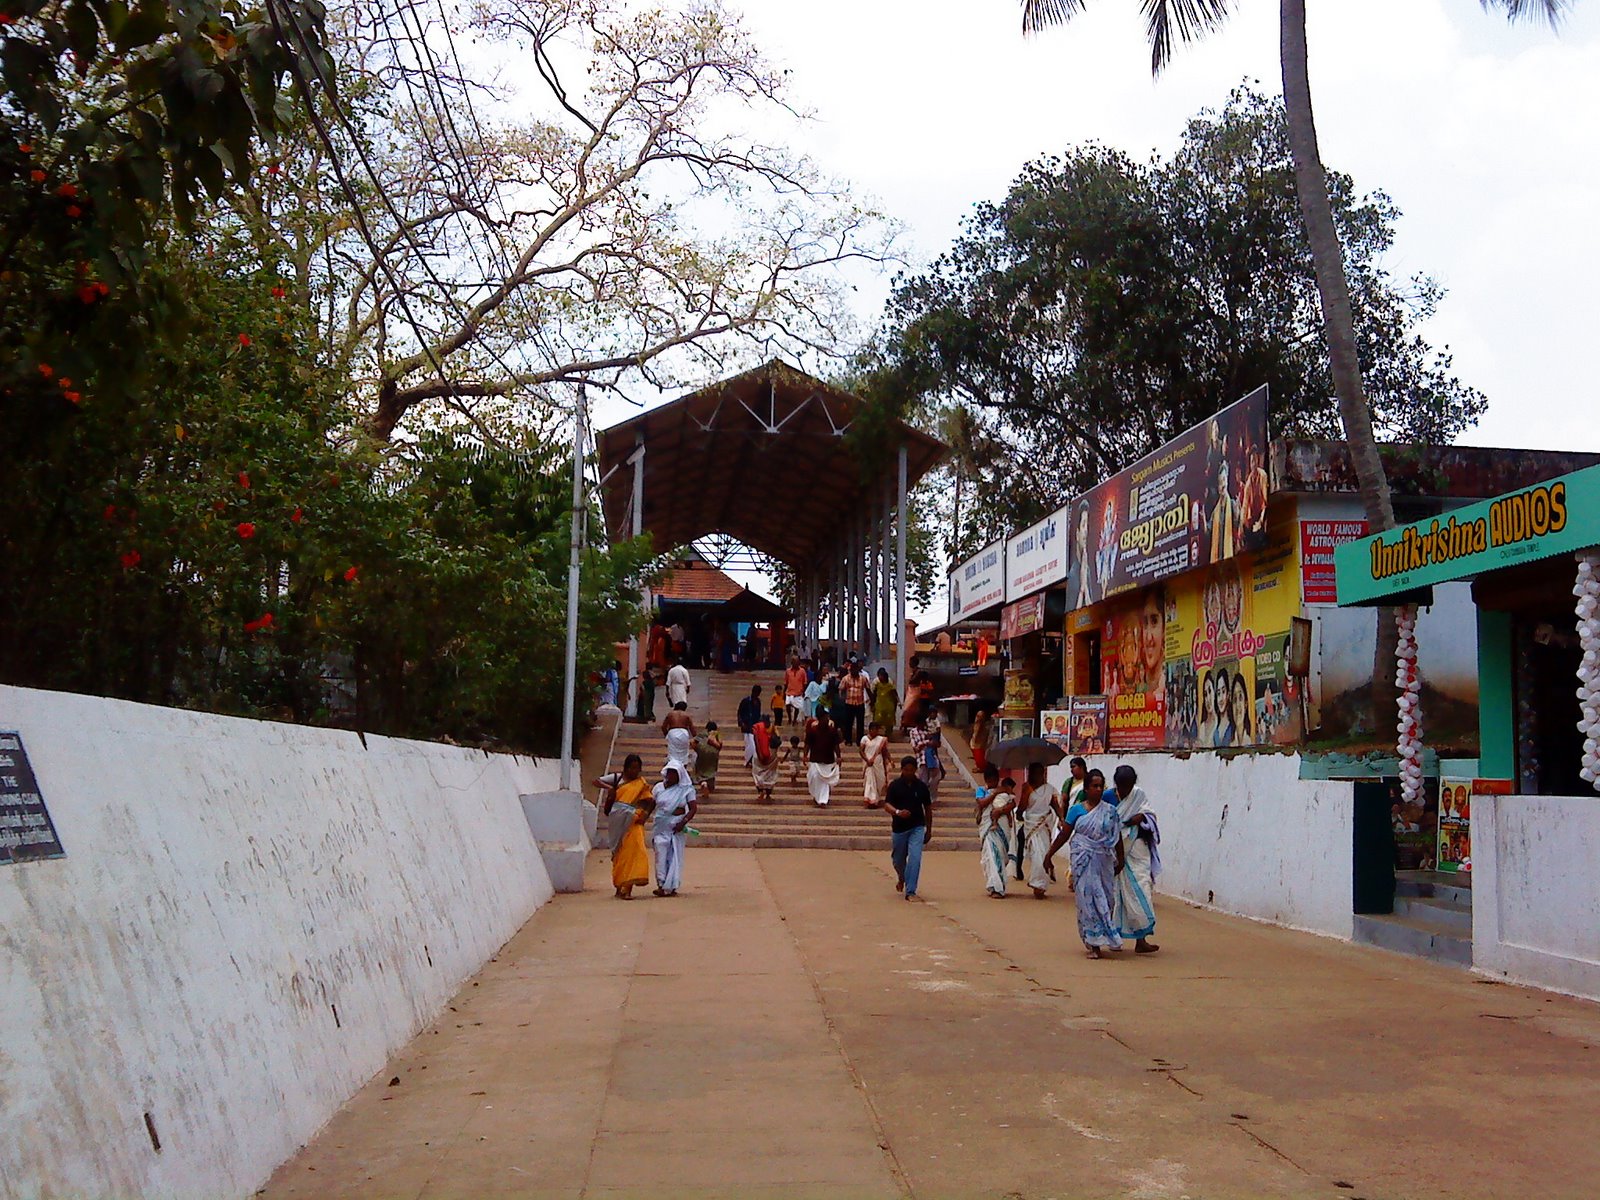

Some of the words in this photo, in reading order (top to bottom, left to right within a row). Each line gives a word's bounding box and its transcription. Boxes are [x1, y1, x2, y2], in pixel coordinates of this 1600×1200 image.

[1306, 523, 1331, 535] WORLD
[1333, 523, 1362, 535] FAMOUS
[1370, 516, 1487, 580] Unnikrishna
[1489, 481, 1567, 548] AUDIOS
[1, 776, 18, 788] THE
